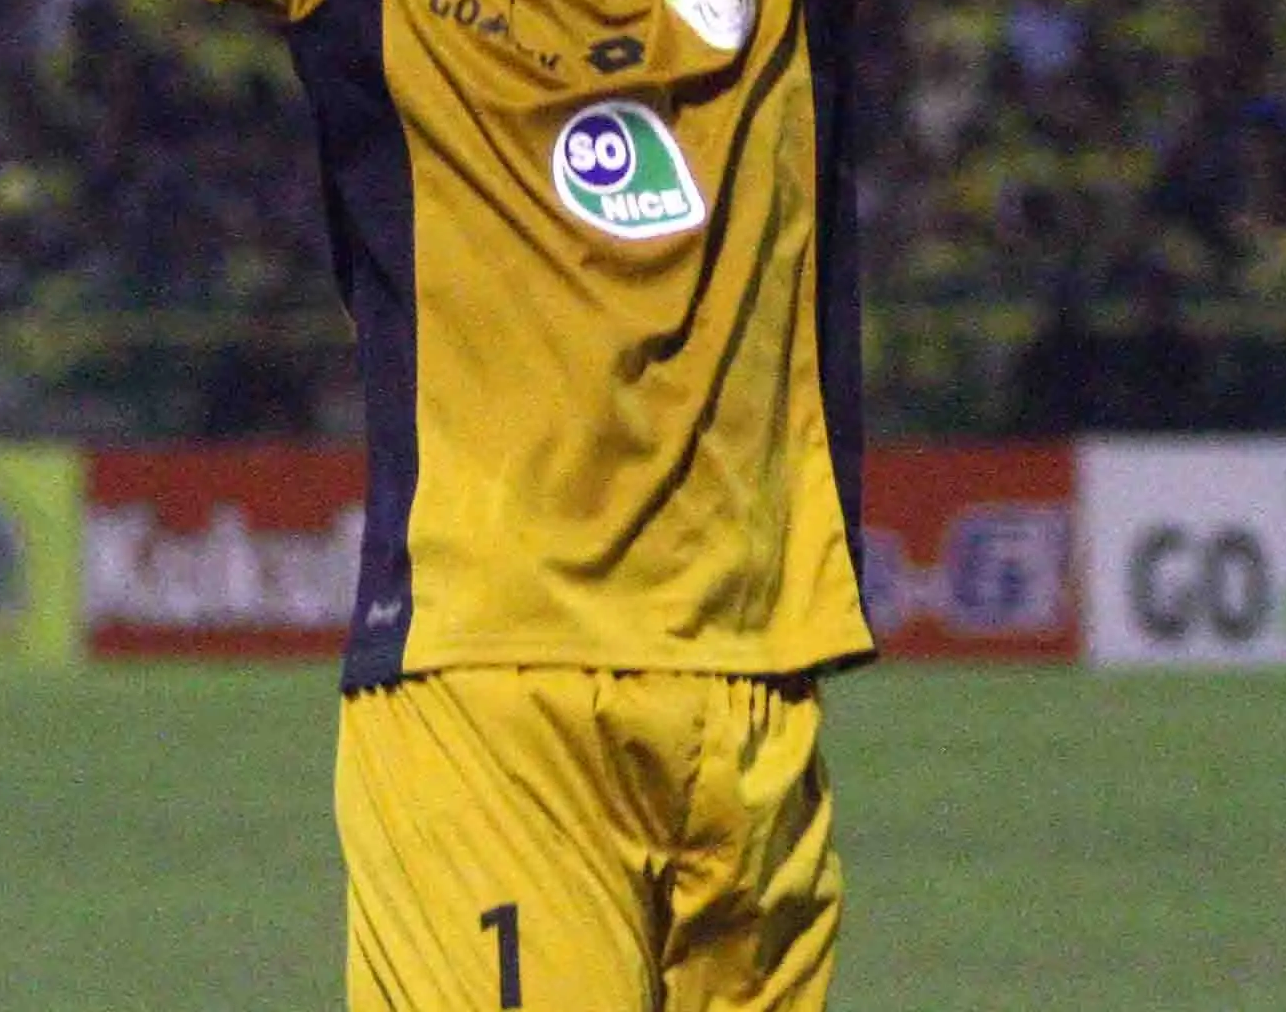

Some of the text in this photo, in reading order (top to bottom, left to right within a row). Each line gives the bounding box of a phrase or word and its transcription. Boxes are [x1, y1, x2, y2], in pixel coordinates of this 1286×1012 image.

[567, 130, 627, 173] SO
[601, 190, 690, 222] NICE
[1127, 520, 1274, 645] GO
[479, 902, 523, 1010] 1
